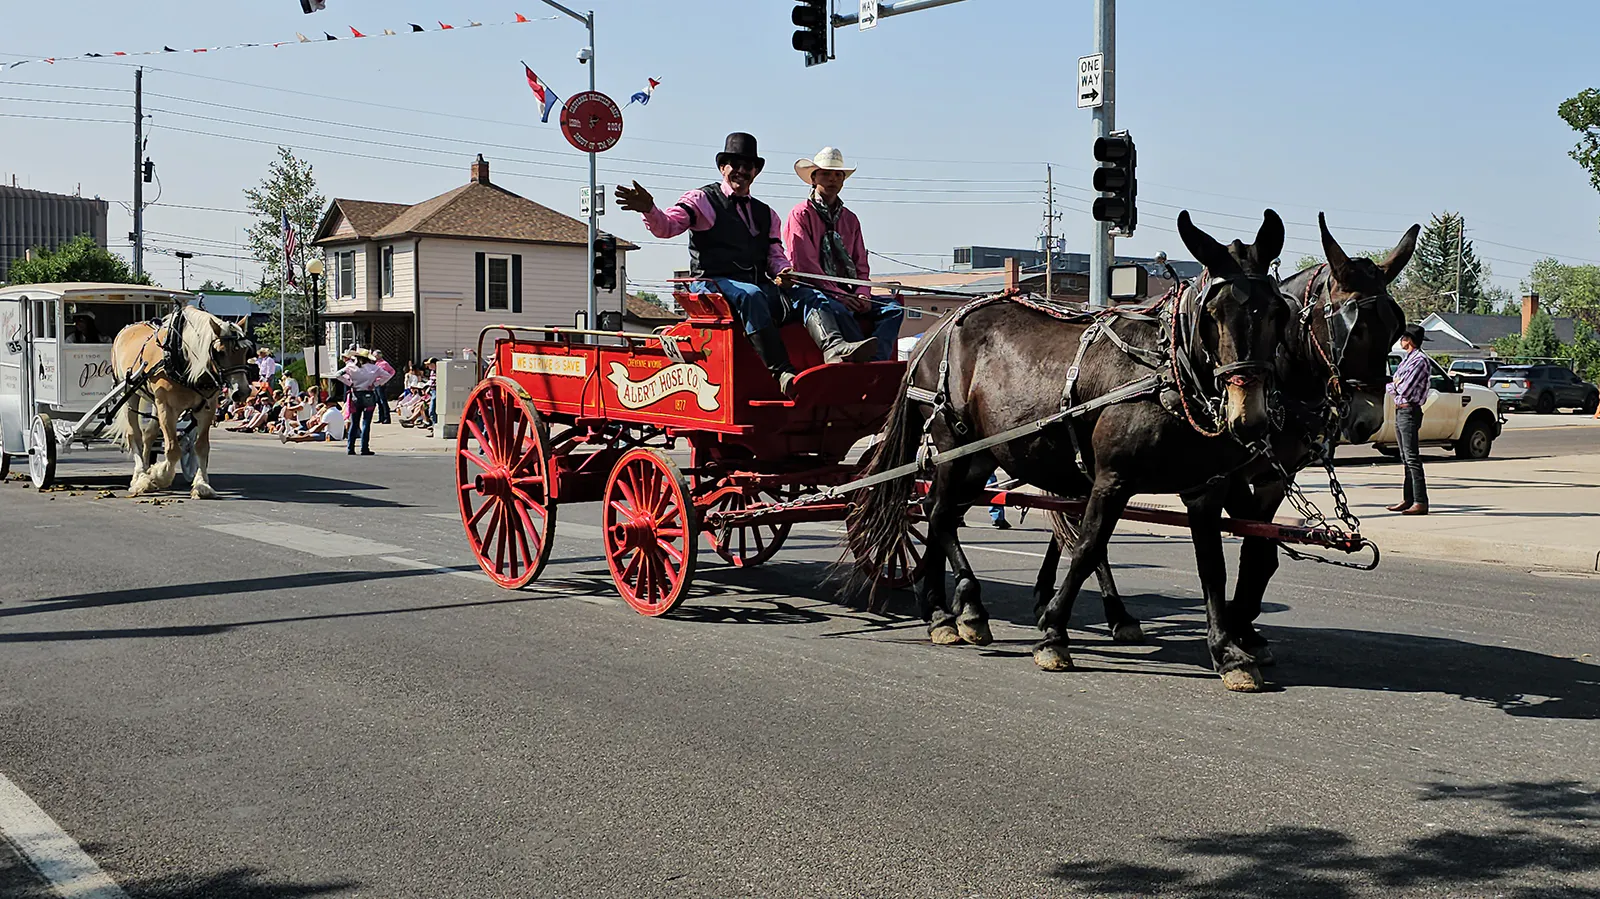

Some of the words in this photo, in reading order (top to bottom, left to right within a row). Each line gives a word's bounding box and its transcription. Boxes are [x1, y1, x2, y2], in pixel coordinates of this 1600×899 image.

[861, 0, 875, 12] WAY
[1081, 59, 1100, 73] ONE
[1081, 73, 1100, 87] WAY
[607, 122, 621, 131] 2024
[581, 188, 590, 196] ONE
[9, 341, 22, 353] 35
[664, 337, 680, 359] 34
[517, 357, 526, 369] WE
[529, 357, 553, 371] STRIVE
[563, 359, 580, 373] SAVE
[623, 381, 656, 404] ALERT
[659, 368, 684, 393] HOSE
